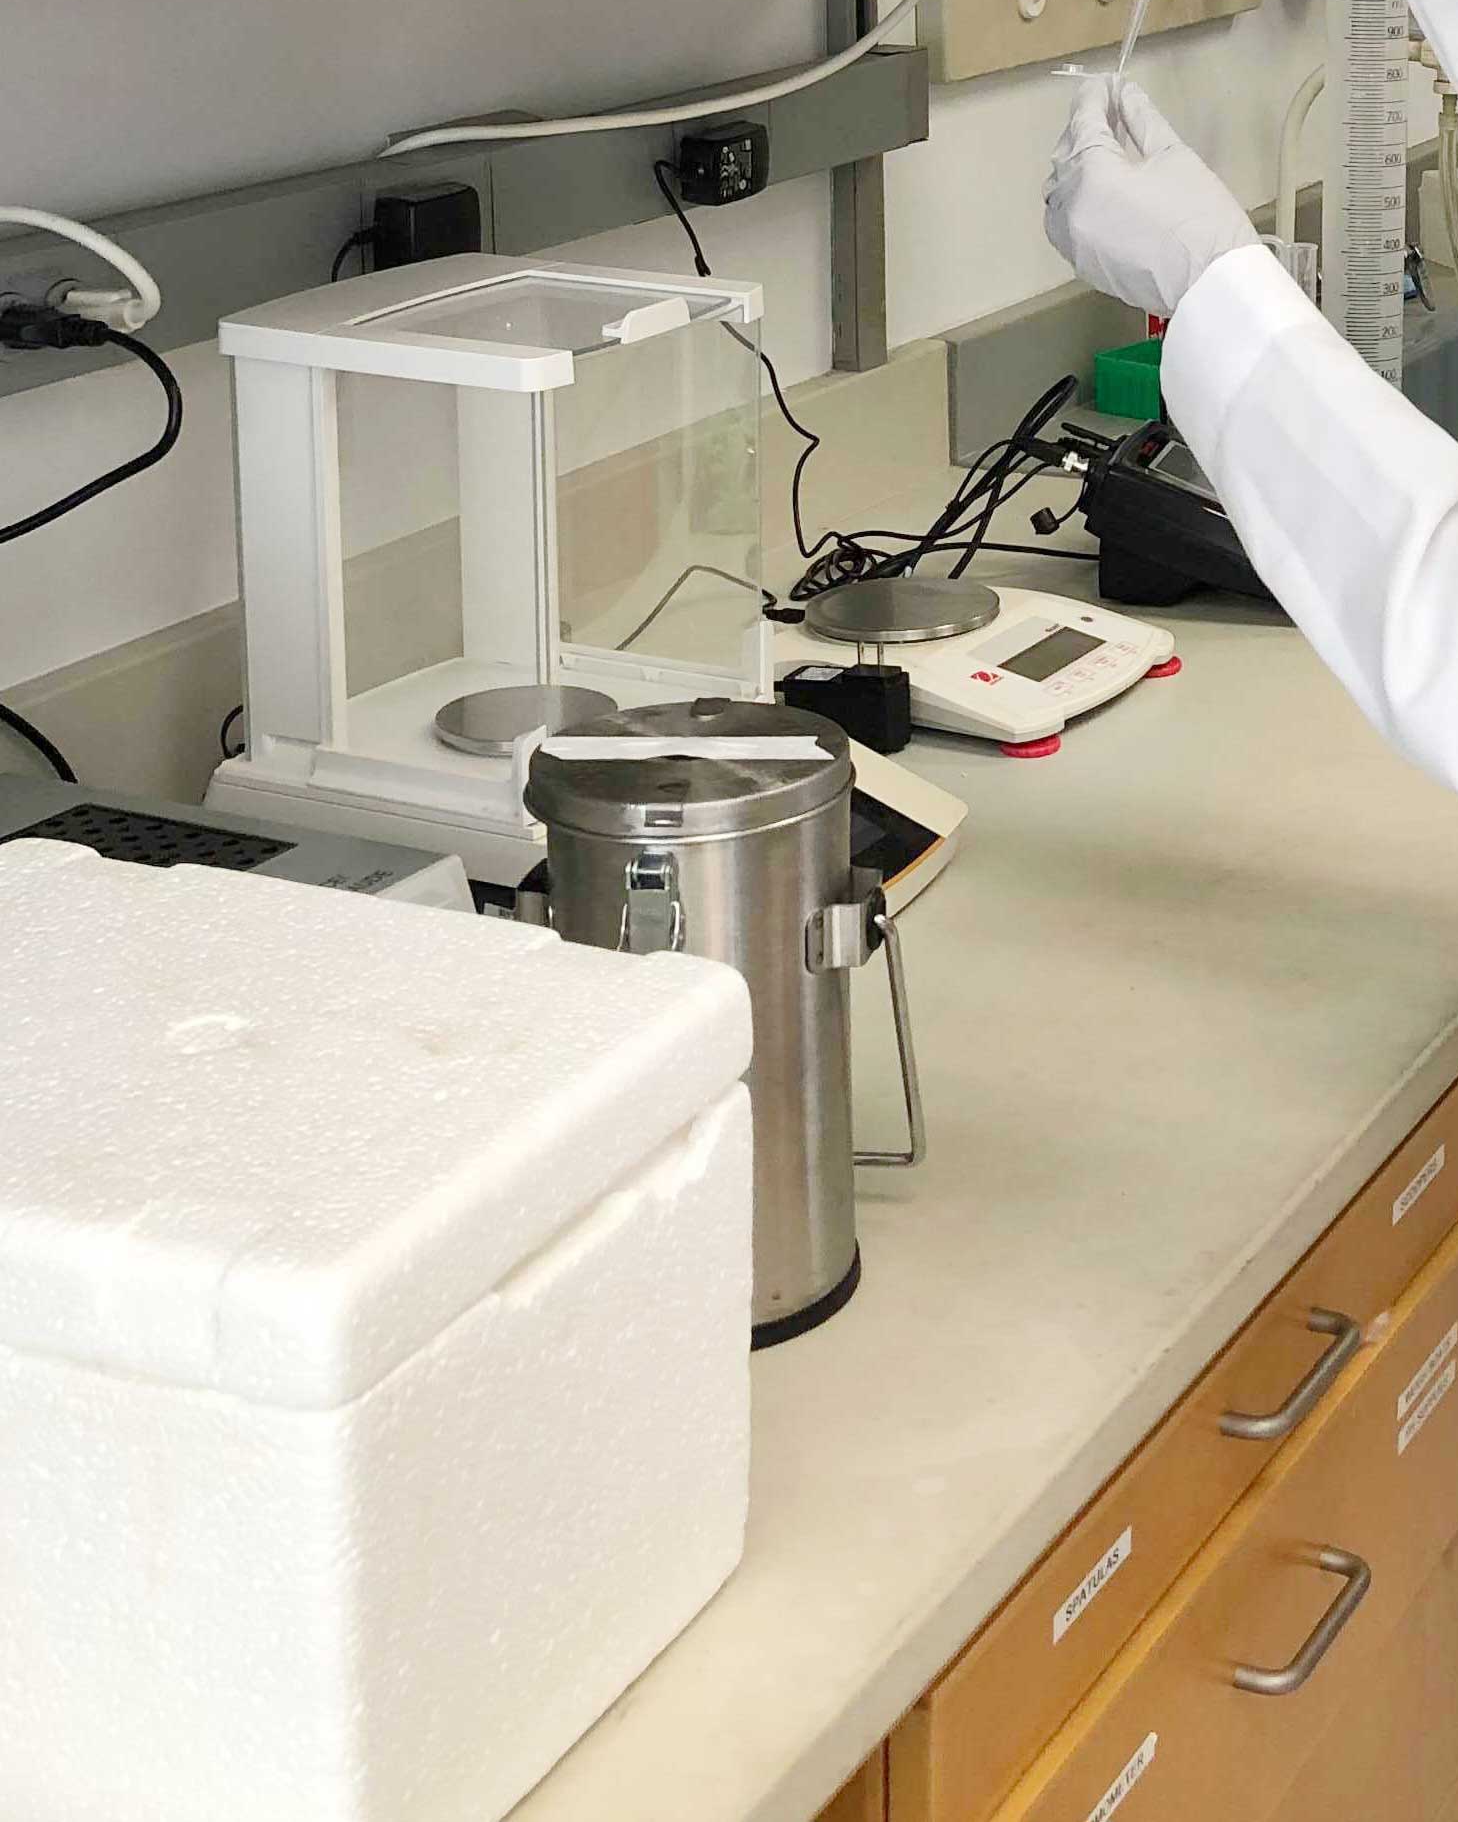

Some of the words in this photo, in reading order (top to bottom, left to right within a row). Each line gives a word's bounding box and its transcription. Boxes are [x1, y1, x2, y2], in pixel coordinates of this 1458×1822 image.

[1387, 25, 1404, 36] 900
[1386, 67, 1403, 79] 800
[1386, 110, 1403, 123] 700
[1384, 152, 1402, 165] 600
[1383, 196, 1401, 209] 500
[1383, 238, 1400, 250] 400
[1383, 281, 1399, 295] 300
[1065, 1547, 1120, 1621] SPATULAS
